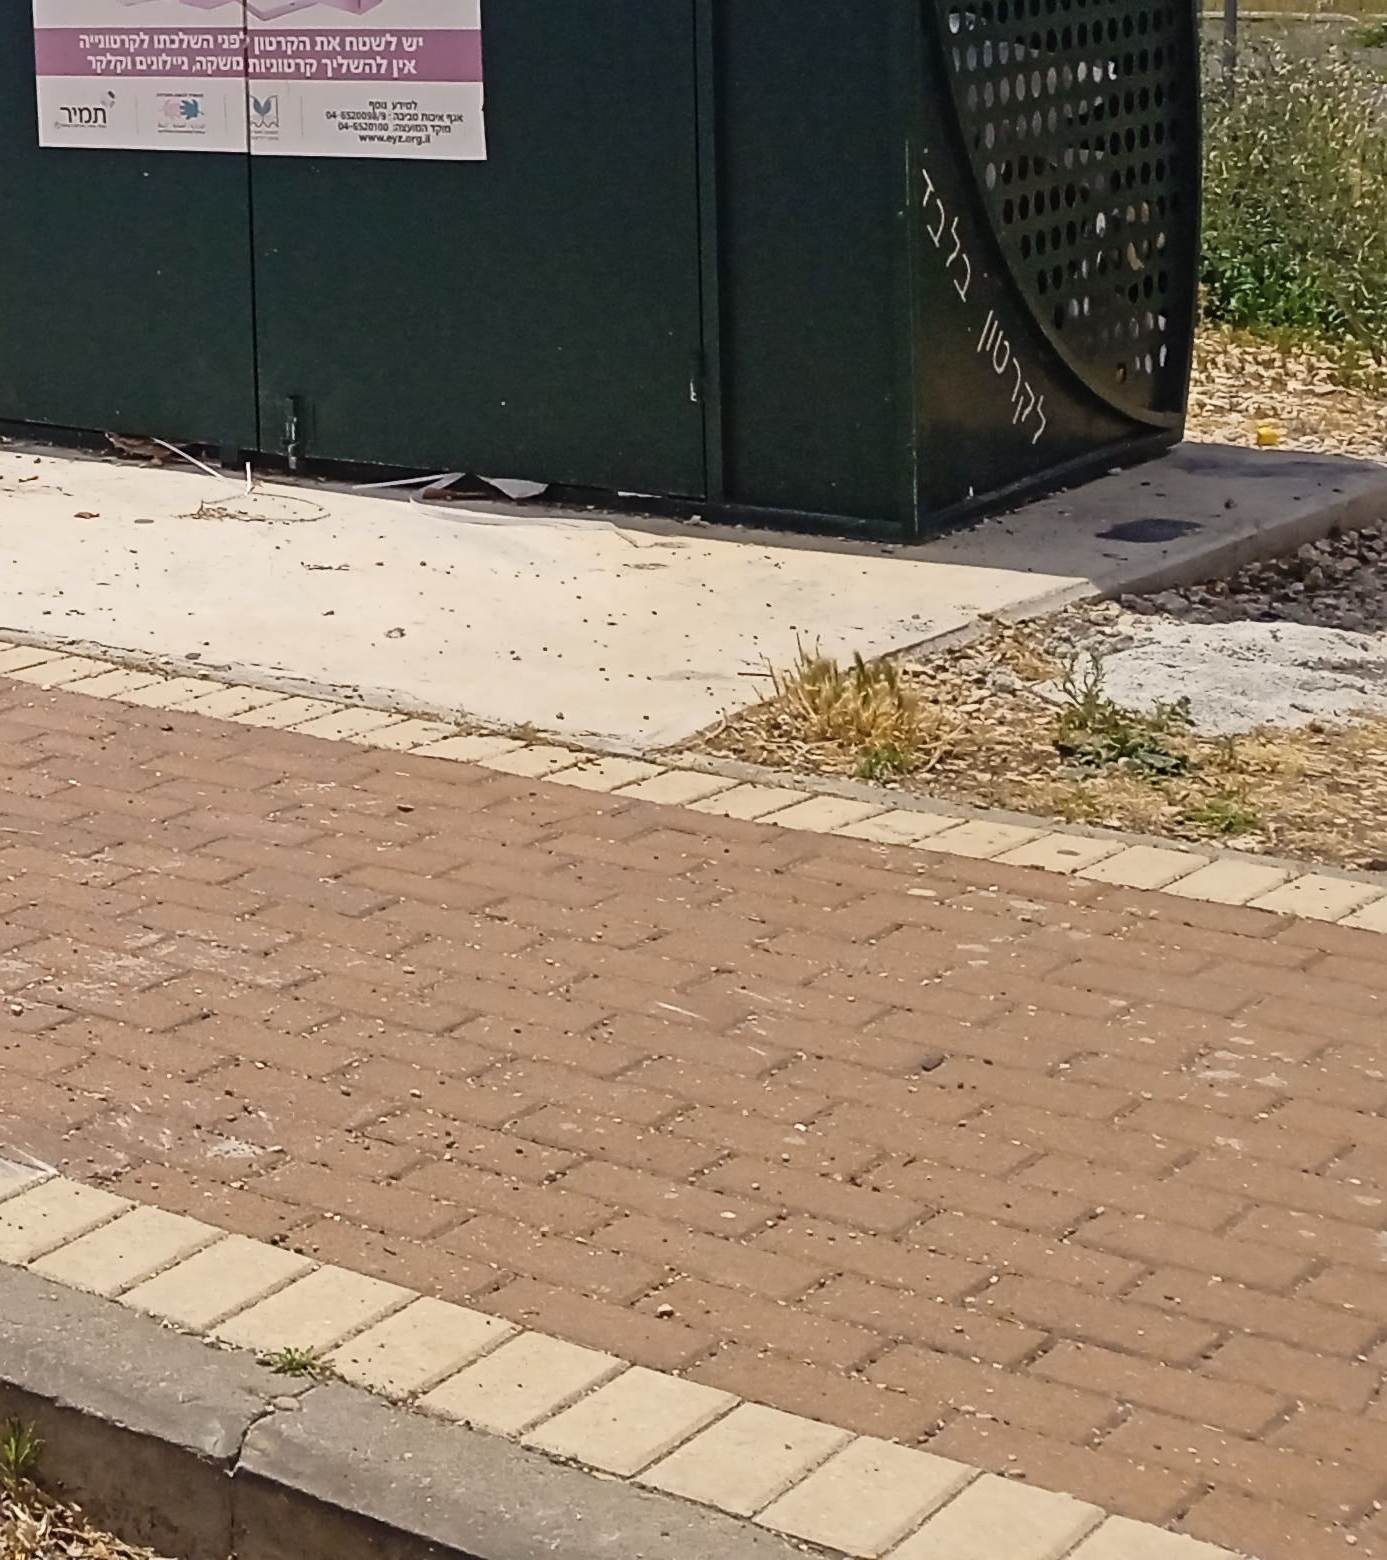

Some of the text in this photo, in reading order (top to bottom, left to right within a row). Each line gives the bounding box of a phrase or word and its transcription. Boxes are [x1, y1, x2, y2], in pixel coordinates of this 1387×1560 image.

[79, 31, 424, 55] יש לשטח את הקרטון לפני השלכתו לקרטונייה
[87, 53, 417, 78] אין להשליך קרטוניות משקה, ניילונים וקלקר
[59, 106, 107, 124] תמיר
[921, 168, 971, 303] בלבד
